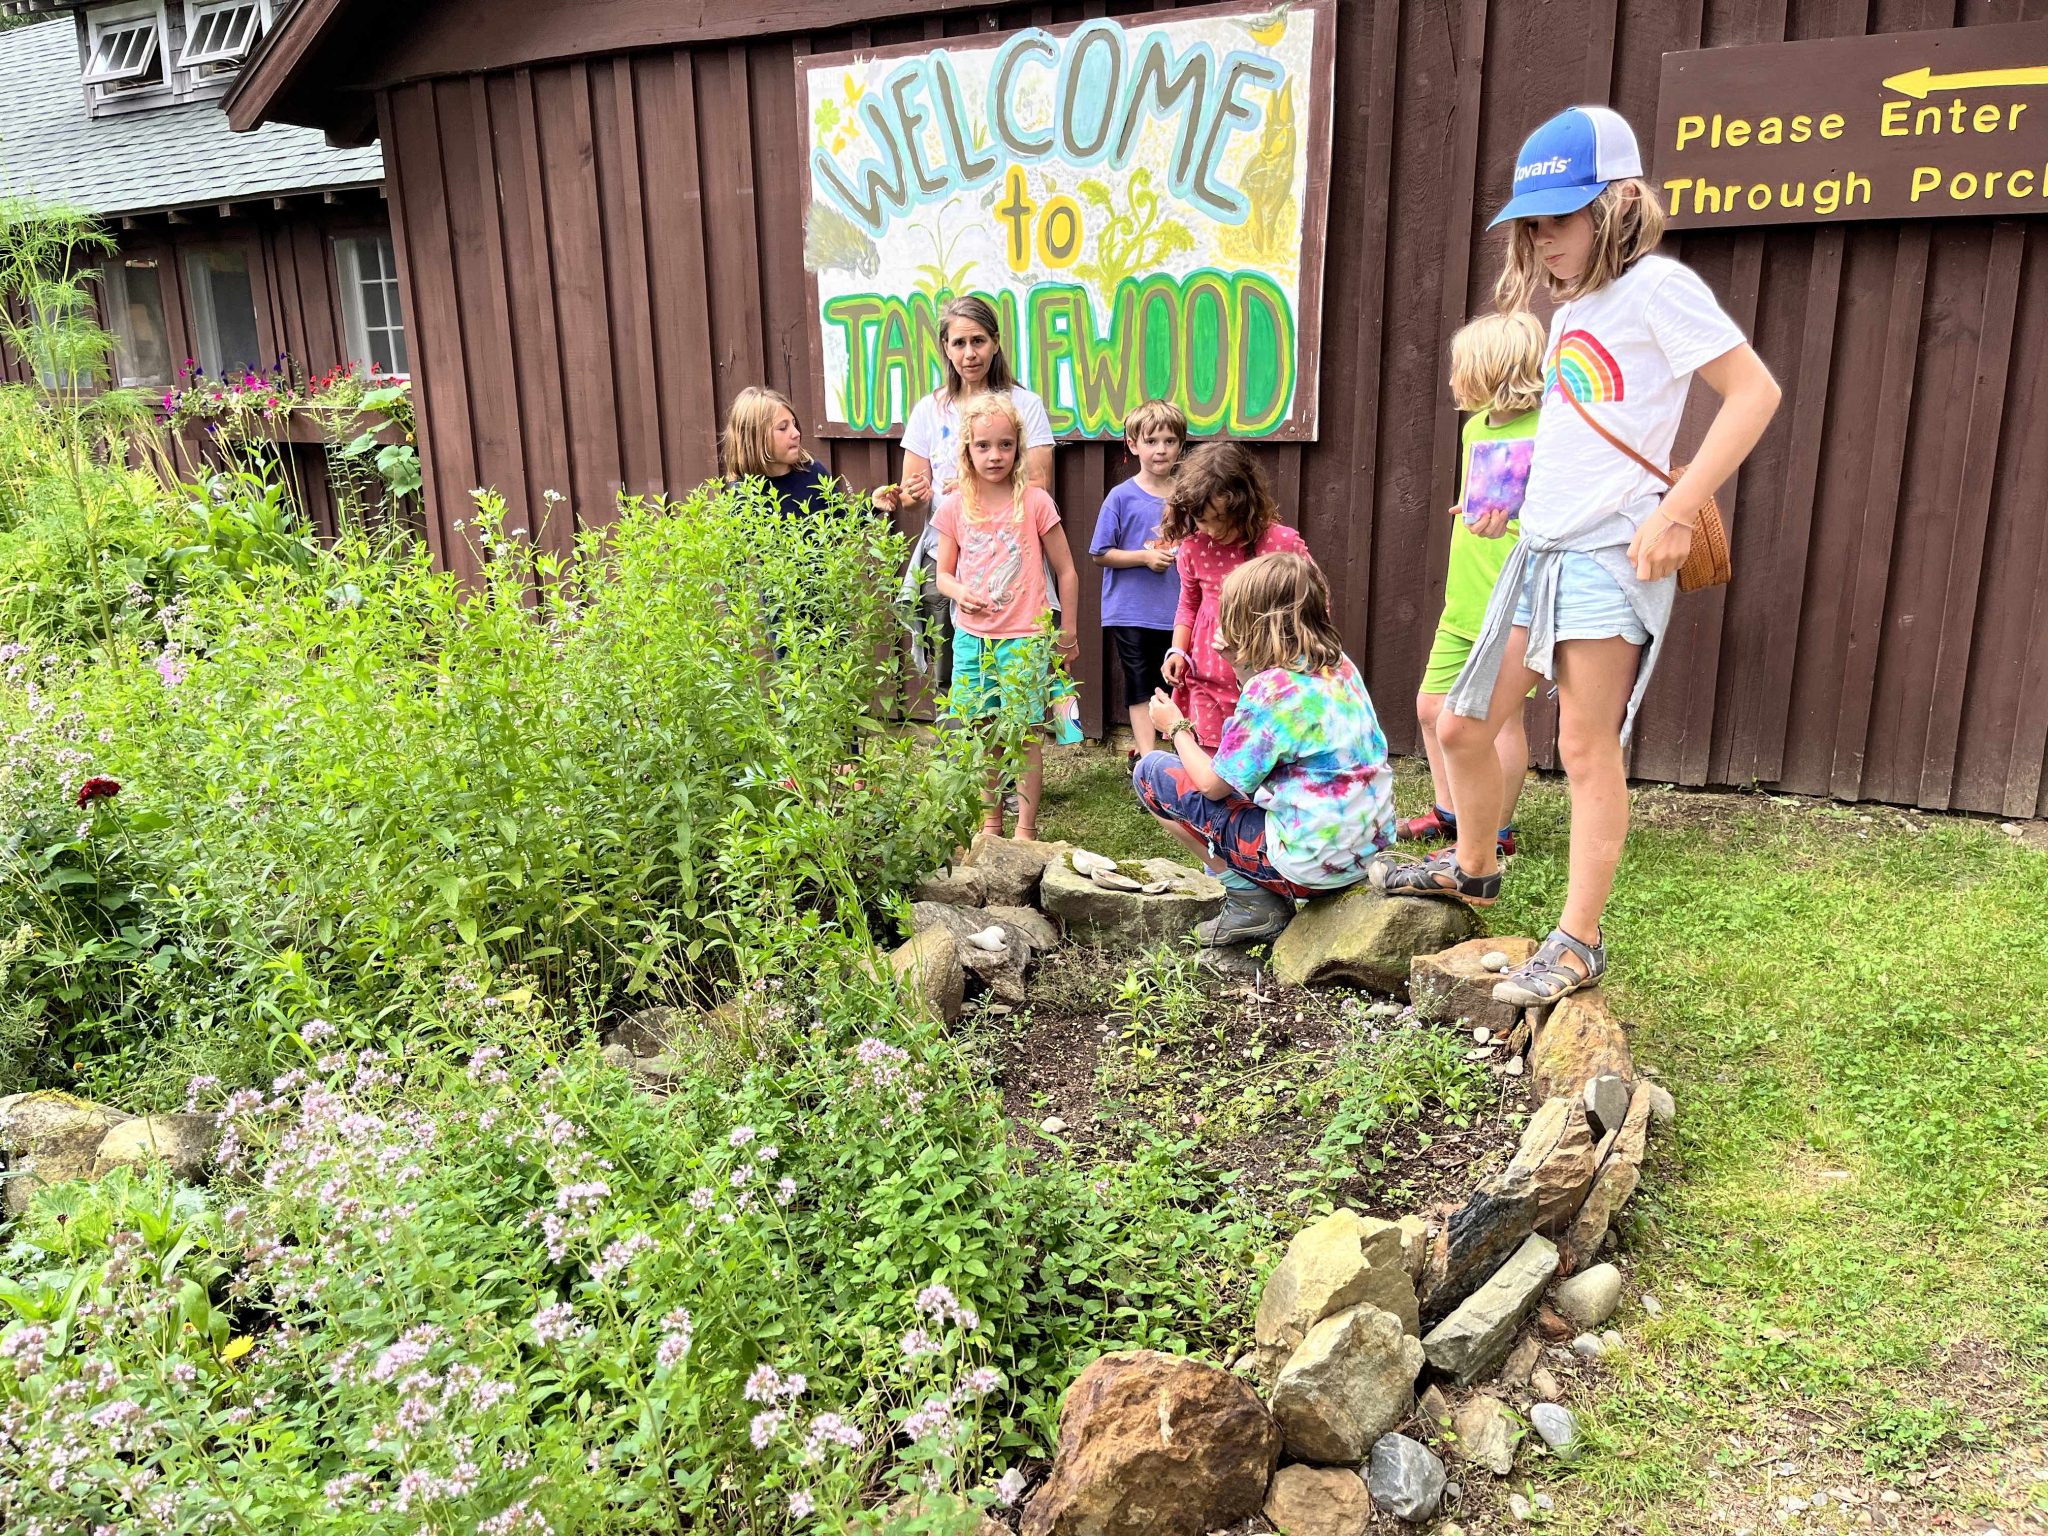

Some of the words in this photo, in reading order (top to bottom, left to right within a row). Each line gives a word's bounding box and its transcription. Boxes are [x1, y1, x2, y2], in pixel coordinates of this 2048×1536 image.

[814, 18, 1285, 237] WELCOME
[1675, 113, 1845, 151] Please
[1880, 98, 2027, 137] Enter
[995, 166, 1083, 272] to
[1663, 171, 1871, 216] Through
[1910, 161, 2048, 203] Porc
